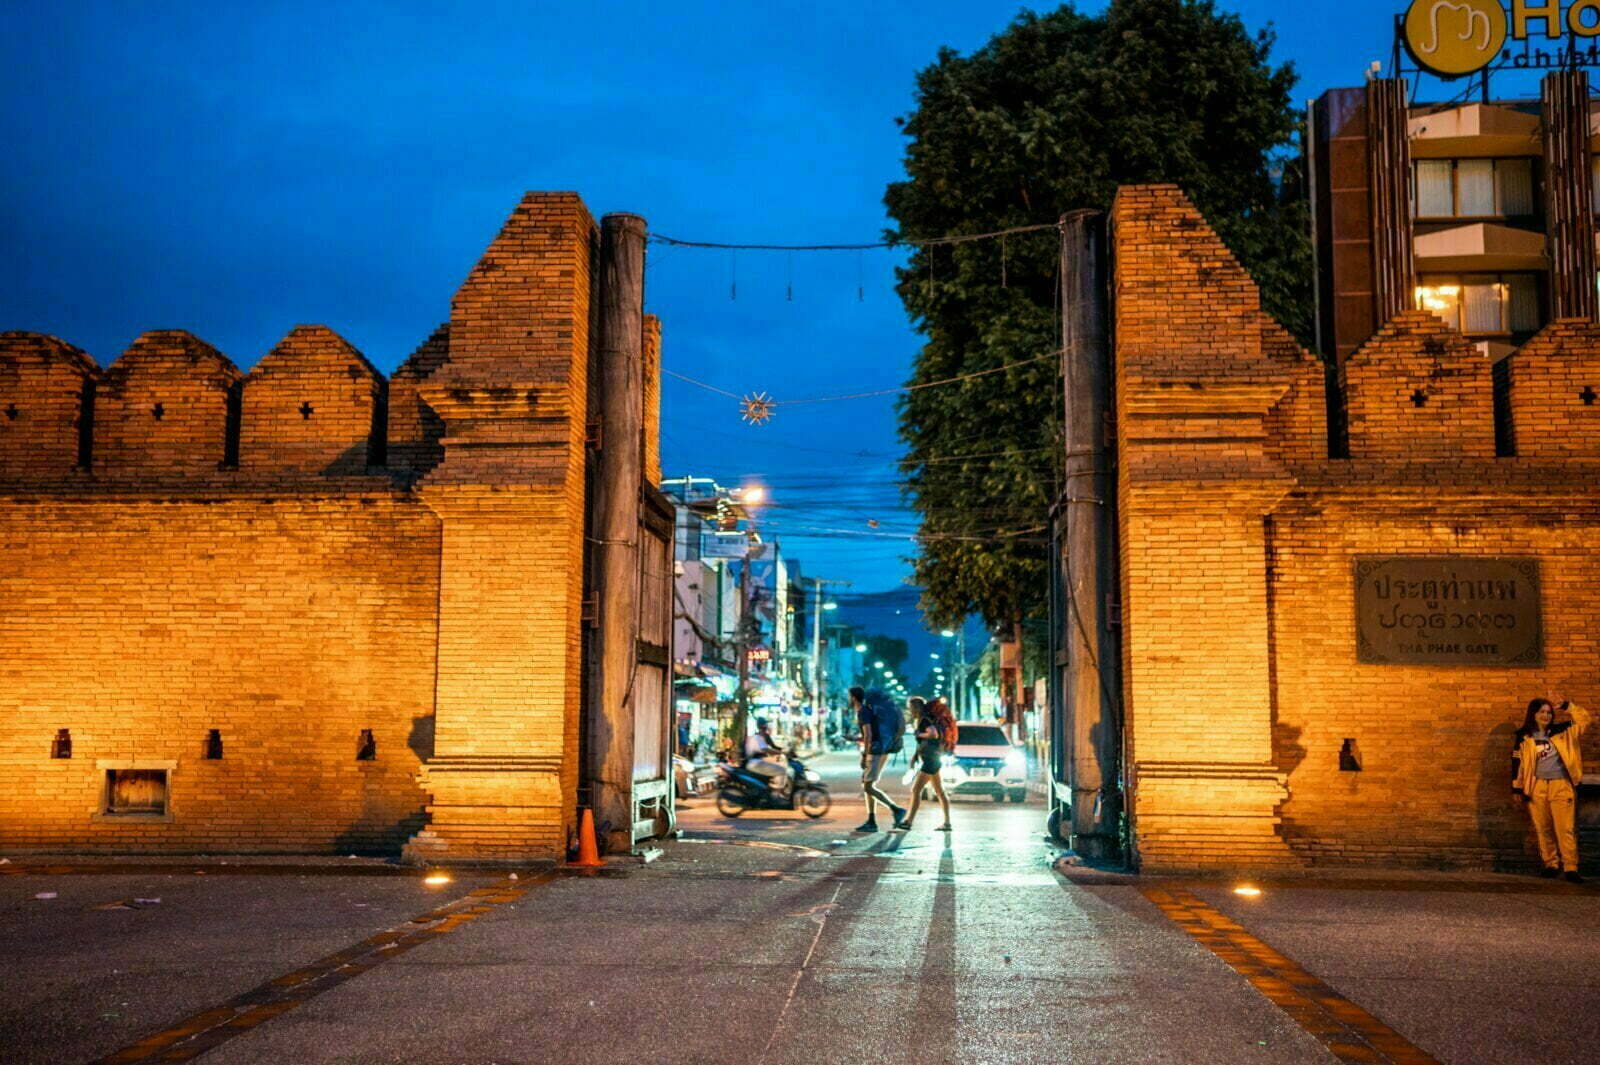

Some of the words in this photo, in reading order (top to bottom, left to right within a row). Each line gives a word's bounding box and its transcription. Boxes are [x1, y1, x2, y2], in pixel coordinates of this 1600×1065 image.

[1374, 573, 1517, 610] ประตูท่าแพ
[1398, 643, 1424, 654] THA
[1428, 643, 1461, 655] PHAE
[1465, 643, 1499, 655] GATE
